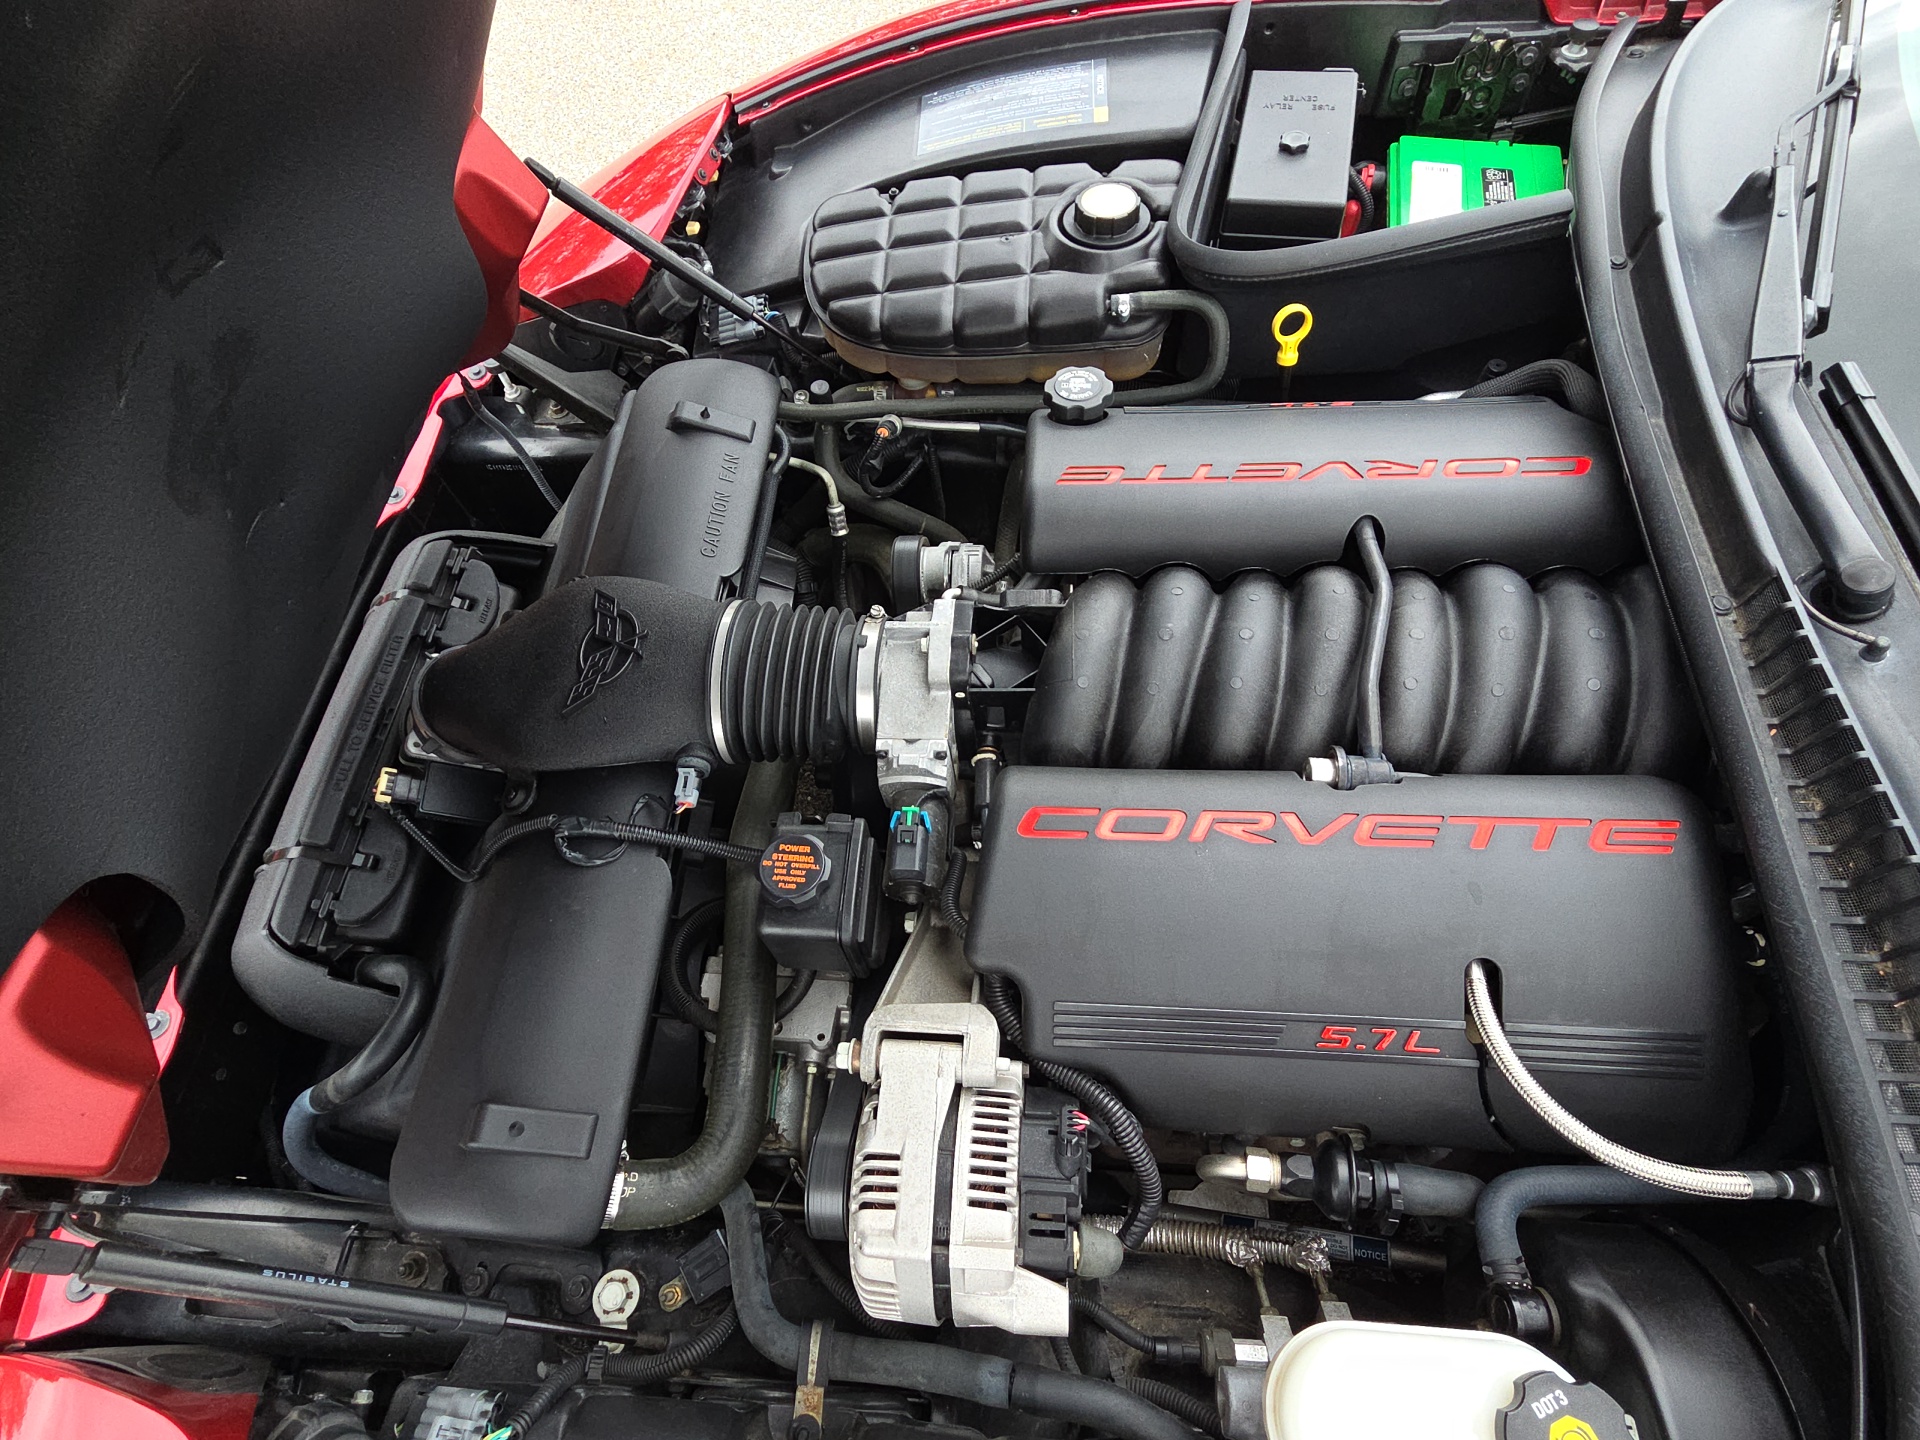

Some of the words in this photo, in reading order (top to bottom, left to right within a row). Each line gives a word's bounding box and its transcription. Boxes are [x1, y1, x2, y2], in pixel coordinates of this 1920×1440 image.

[1283, 94, 1318, 102] CENTER
[1056, 456, 1594, 486] CORVETTE
[700, 490, 731, 558] CAUTION
[719, 452, 740, 483] FAN
[332, 755, 356, 793] PULL
[347, 736, 363, 757] TO
[356, 682, 386, 732] SERVICE
[379, 635, 404, 675] FILTER
[1017, 806, 1682, 856] CORVETTE
[772, 853, 814, 863] STEERING
[779, 844, 811, 853] POWER
[791, 862, 820, 870] OVERFILL
[772, 875, 806, 883] APPROVED
[1317, 1026, 1441, 1056] 5.7L
[1355, 1248, 1388, 1262] NOTICE
[262, 1269, 350, 1288] STABILUS
[1531, 1393, 1559, 1419] DOT
[1555, 1389, 1569, 1405] 3
